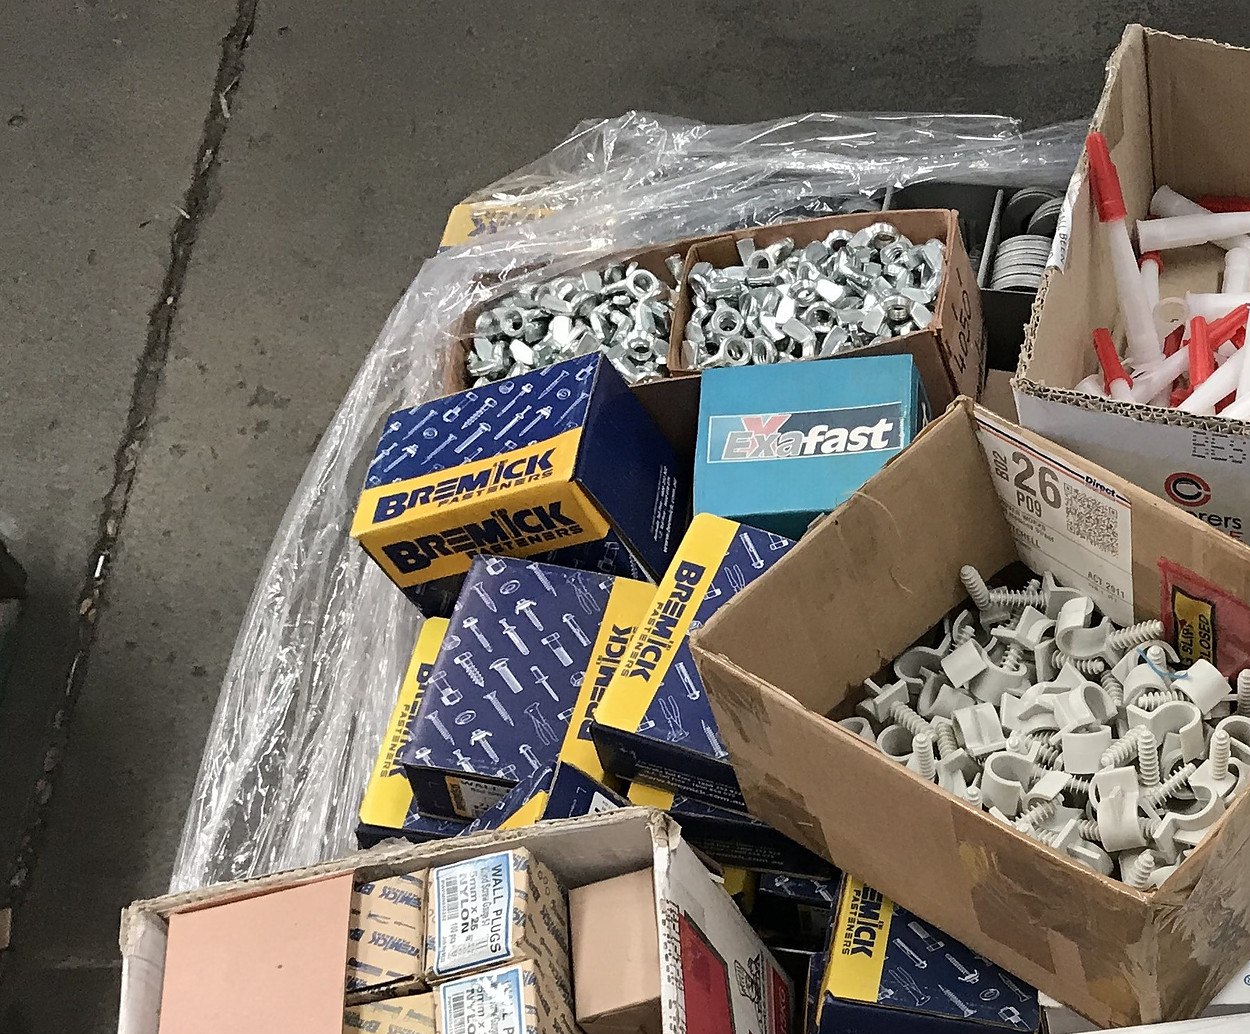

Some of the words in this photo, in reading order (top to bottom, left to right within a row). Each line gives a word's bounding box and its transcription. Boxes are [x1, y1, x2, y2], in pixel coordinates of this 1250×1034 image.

[372, 447, 557, 524] BREMICK
[437, 467, 554, 507] FASTENERS
[1011, 451, 1062, 509] 26
[1016, 491, 1042, 518] P09
[1084, 475, 1117, 498] Direct
[381, 501, 578, 574] BREMICK
[620, 600, 664, 678] FASTENERS
[628, 559, 706, 683] BREMICK
[459, 873, 470, 933] NYLON
[491, 863, 504, 904] WALL
[489, 908, 503, 954] PLUGS
[841, 888, 862, 955] FASTENERS
[850, 886, 883, 958] EMICK
